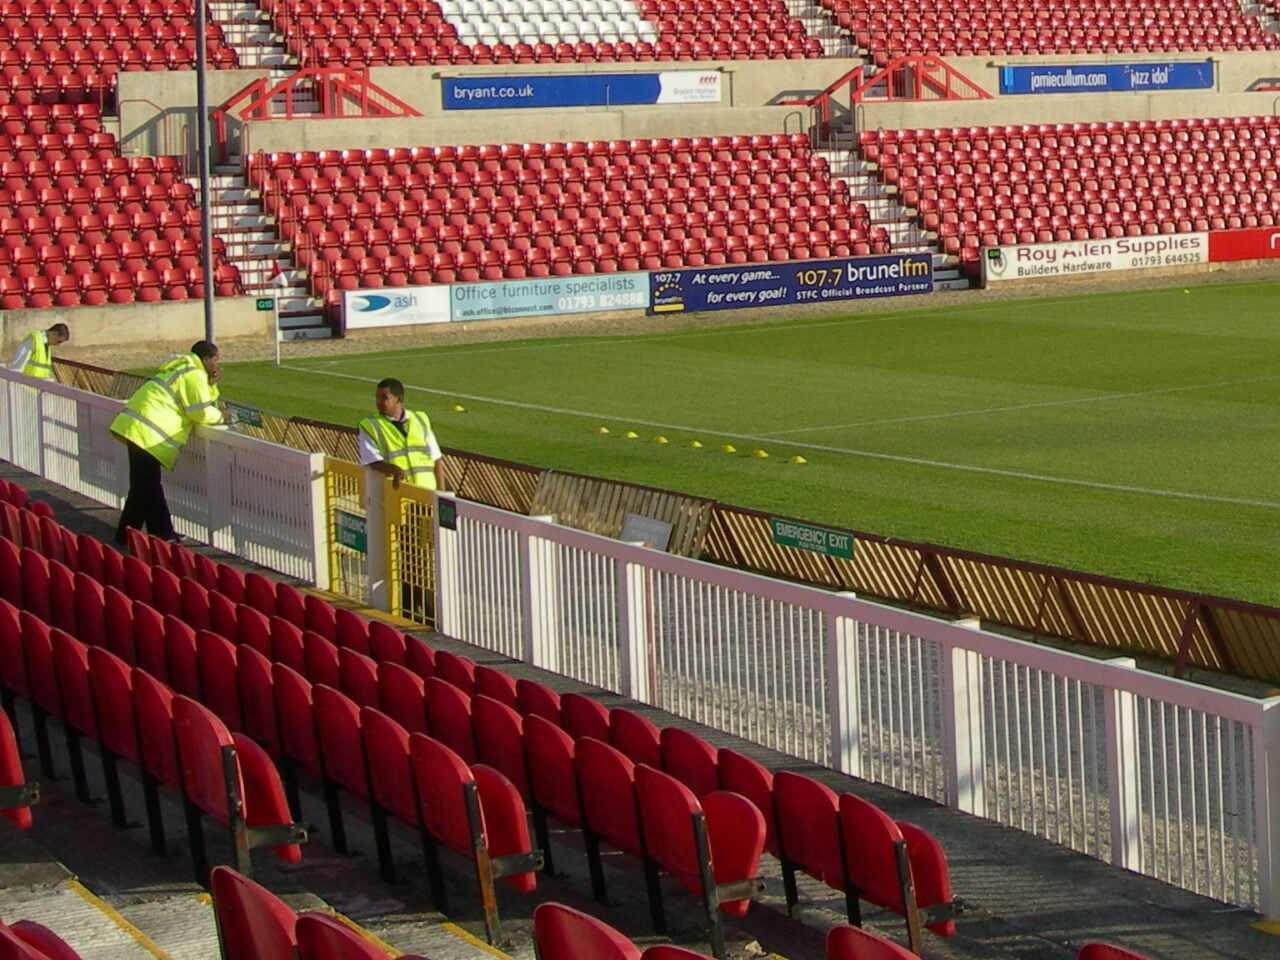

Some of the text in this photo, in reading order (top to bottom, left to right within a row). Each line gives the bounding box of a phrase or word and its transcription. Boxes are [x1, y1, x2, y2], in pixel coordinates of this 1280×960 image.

[1030, 69, 1107, 91] jamiecullum.com
[453, 84, 534, 101] bryant.co.uk
[1017, 247, 1057, 263] Roy
[1116, 236, 1200, 255] Supplies
[1017, 260, 1111, 276] Builders Hardware
[1131, 252, 1200, 267] 01793 644525
[654, 272, 681, 284] 107.7
[691, 273, 706, 285] At
[708, 274, 738, 288] every
[797, 269, 843, 287] 107.7
[455, 276, 635, 301] Office furniture specialists
[707, 286, 787, 306] for every goal!
[797, 281, 929, 300] STFC Official Broadcast Partner
[394, 294, 417, 307] ash
[558, 296, 594, 310] 01793
[776, 523, 827, 545] EMERGENCY
[828, 534, 848, 550] EXIT
